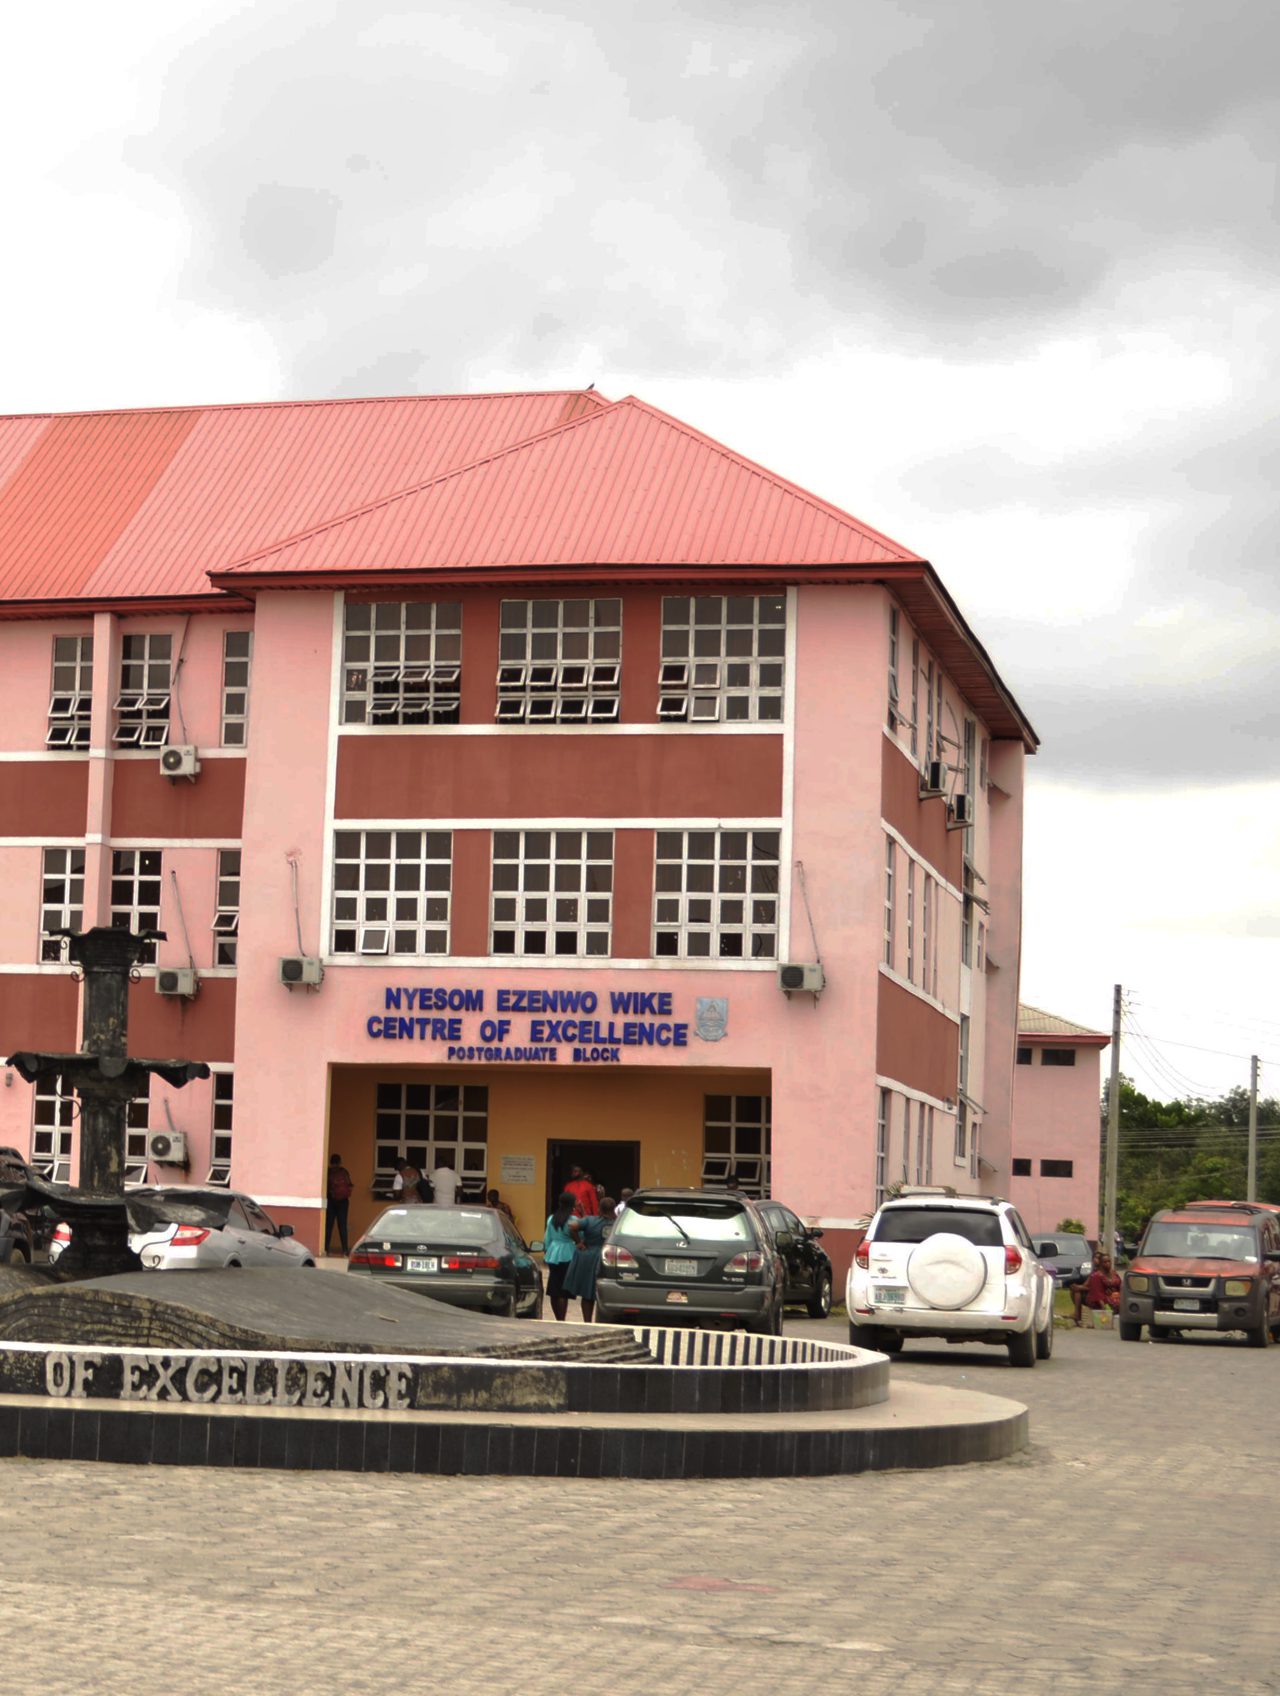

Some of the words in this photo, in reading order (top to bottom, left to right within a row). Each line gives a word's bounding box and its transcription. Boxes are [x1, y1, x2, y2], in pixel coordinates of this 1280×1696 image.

[385, 987, 484, 1011] NYESOM
[496, 989, 598, 1013] EZENWO
[610, 991, 672, 1014] WIKE
[367, 1016, 462, 1041] CENTRE
[480, 1019, 511, 1042] OF
[530, 1019, 688, 1046] EXCELLENCE
[448, 1046, 557, 1061] POSTGRADUATE
[573, 1047, 620, 1062] BLOCK
[45, 1350, 102, 1398] OF
[122, 1353, 413, 1410] EXCELLENCE
